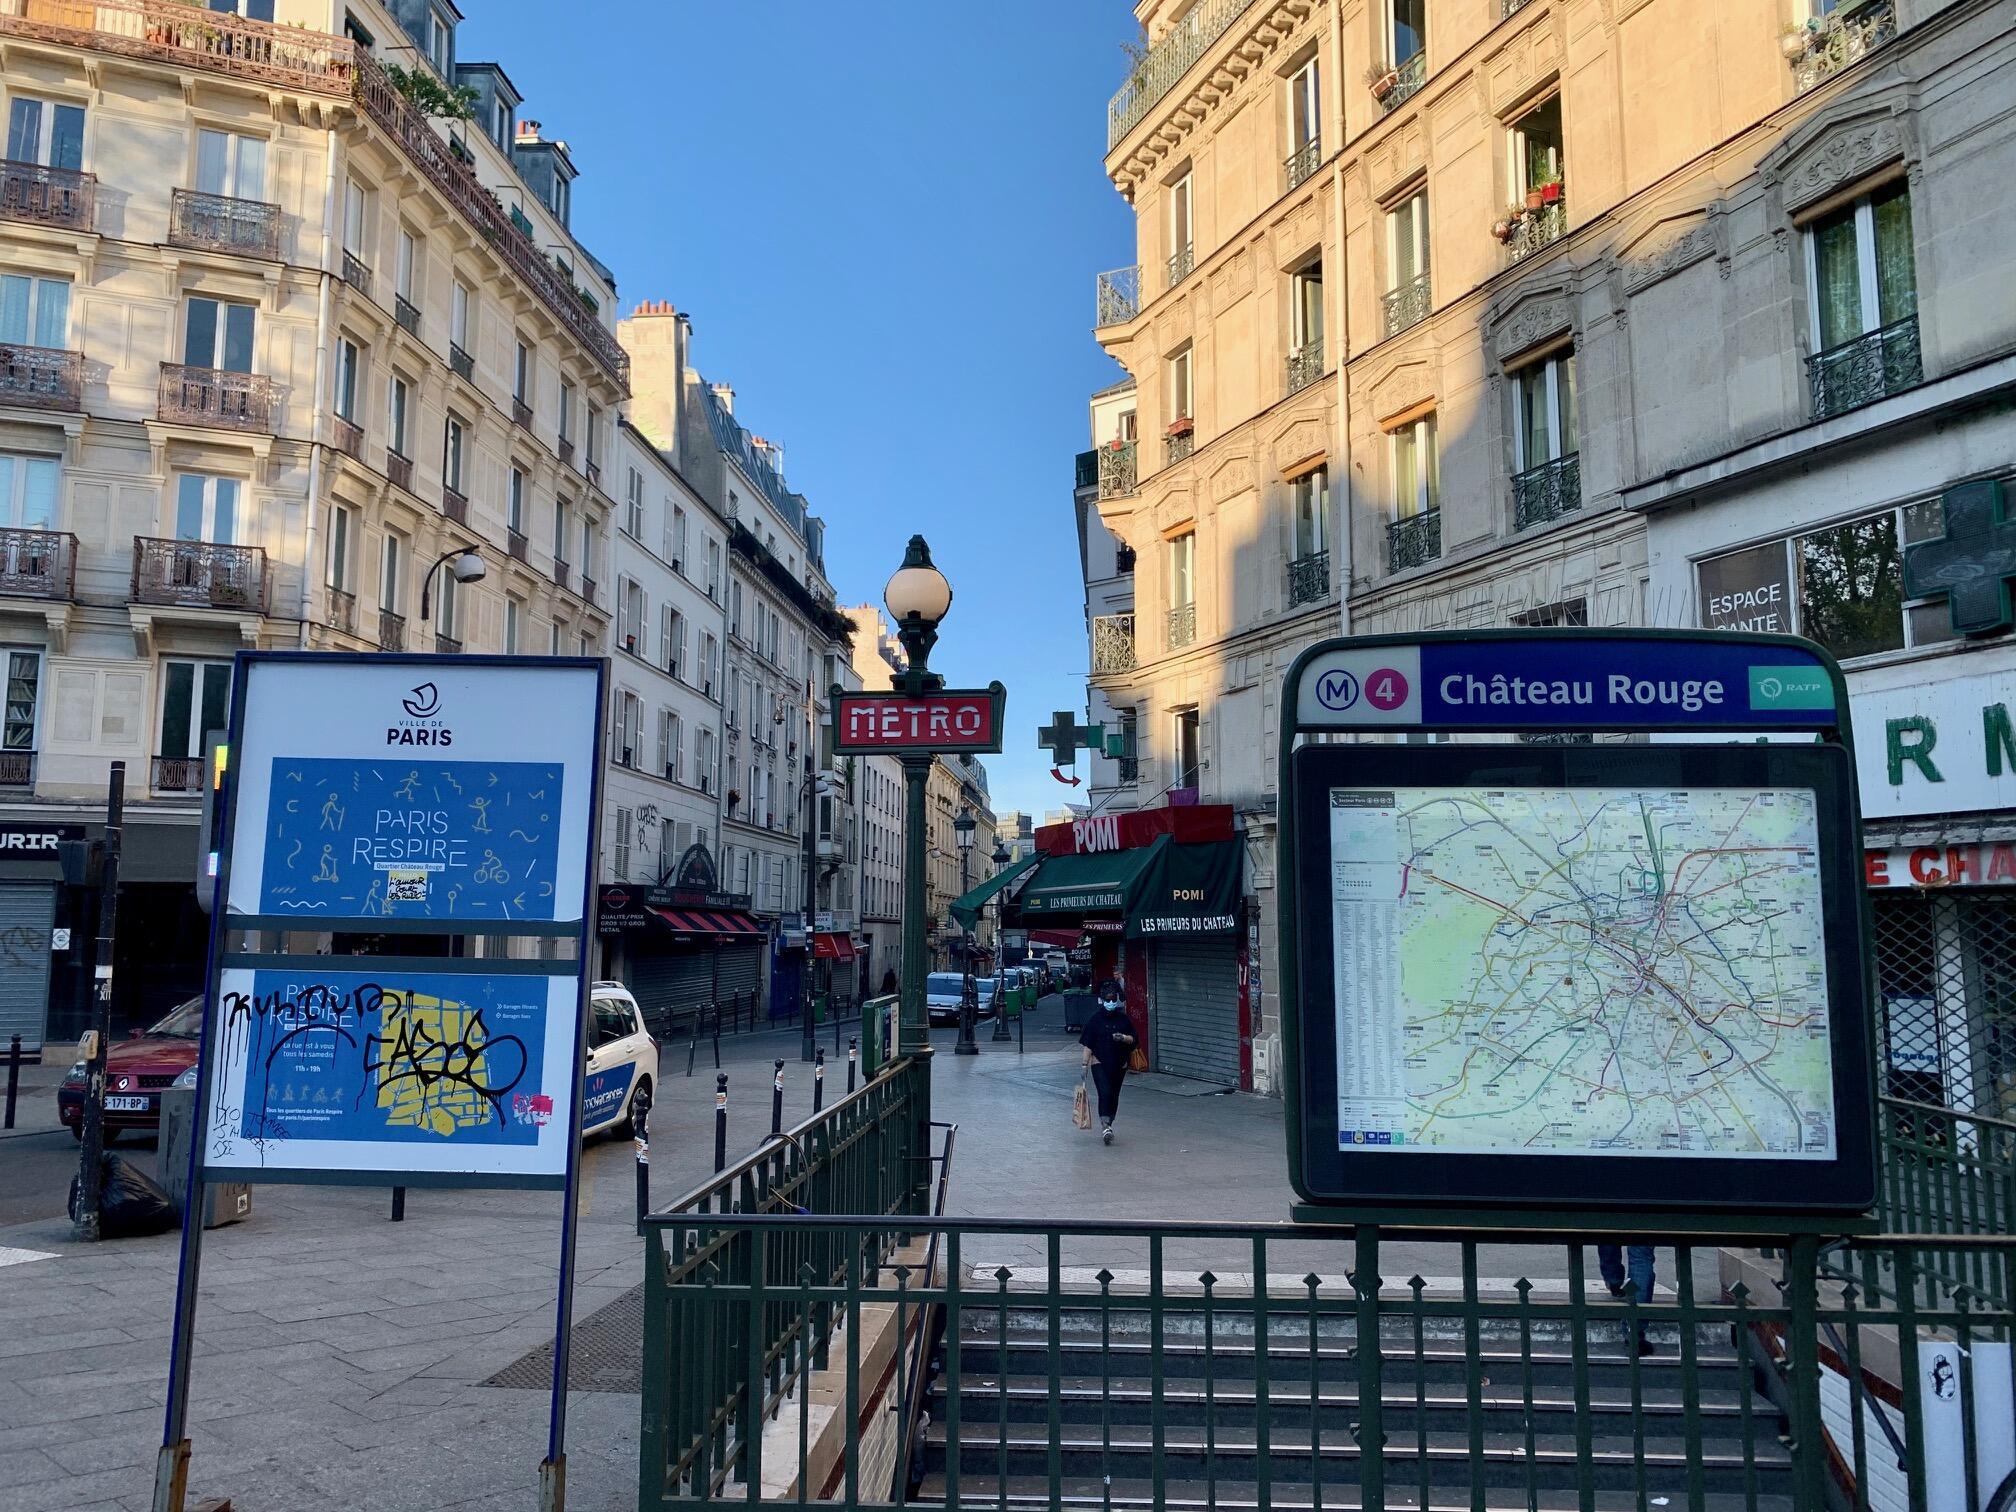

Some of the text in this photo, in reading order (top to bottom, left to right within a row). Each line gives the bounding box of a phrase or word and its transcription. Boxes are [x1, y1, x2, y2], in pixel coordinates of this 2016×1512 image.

[1710, 583, 1782, 615] ESPACE
[1375, 677, 1395, 701] 4
[1440, 673, 1594, 706] Château
[1608, 674, 1724, 712] Rouge
[1786, 683, 1821, 692] RATP
[431, 720, 443, 728] DE
[850, 706, 981, 738] METRO
[386, 728, 452, 747] PARIS
[375, 809, 449, 835] PARIS
[1072, 815, 1120, 854] POMI
[352, 837, 469, 867] RESPIRE
[1050, 893, 1123, 909] LES PRIMEURS DU CHATEAU
[1173, 889, 1204, 901] POMI
[1140, 913, 1235, 932] LES PRIMEURS DU CHATEAU
